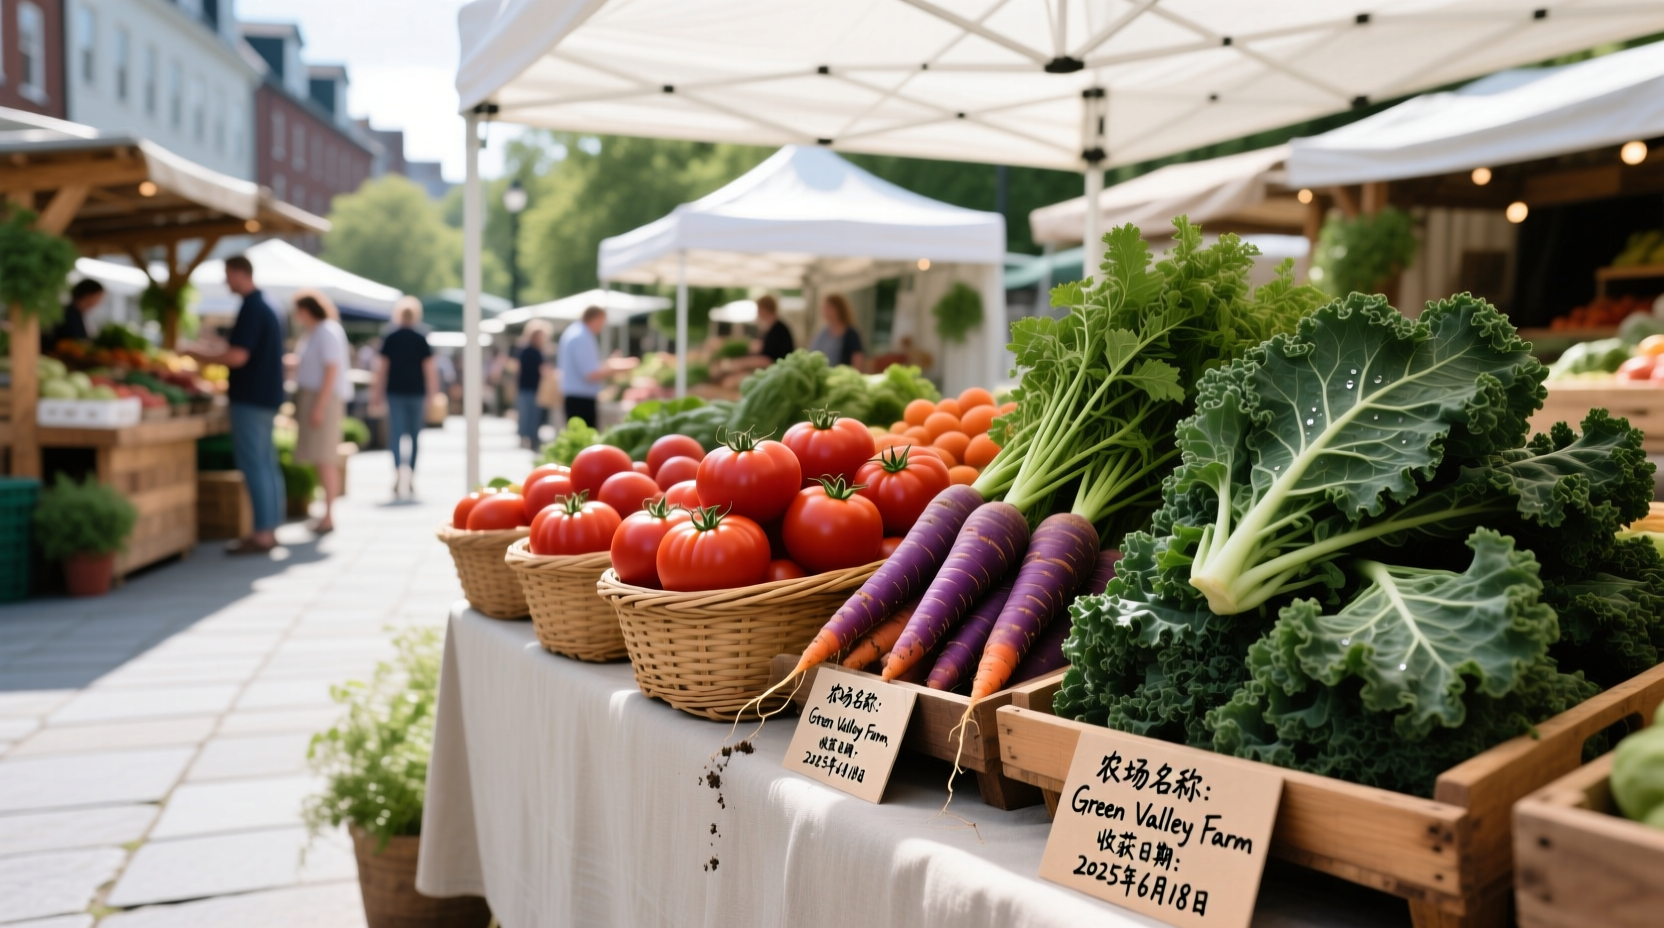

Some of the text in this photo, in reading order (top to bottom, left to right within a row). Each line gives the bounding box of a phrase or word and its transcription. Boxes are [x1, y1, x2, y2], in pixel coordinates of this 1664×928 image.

[1096, 750, 1211, 802] 农场名称：
[1071, 785, 1253, 855] Green Valley Farm
[1096, 828, 1181, 871] 收获日期：
[1073, 855, 1209, 916] 2025年6月18日
